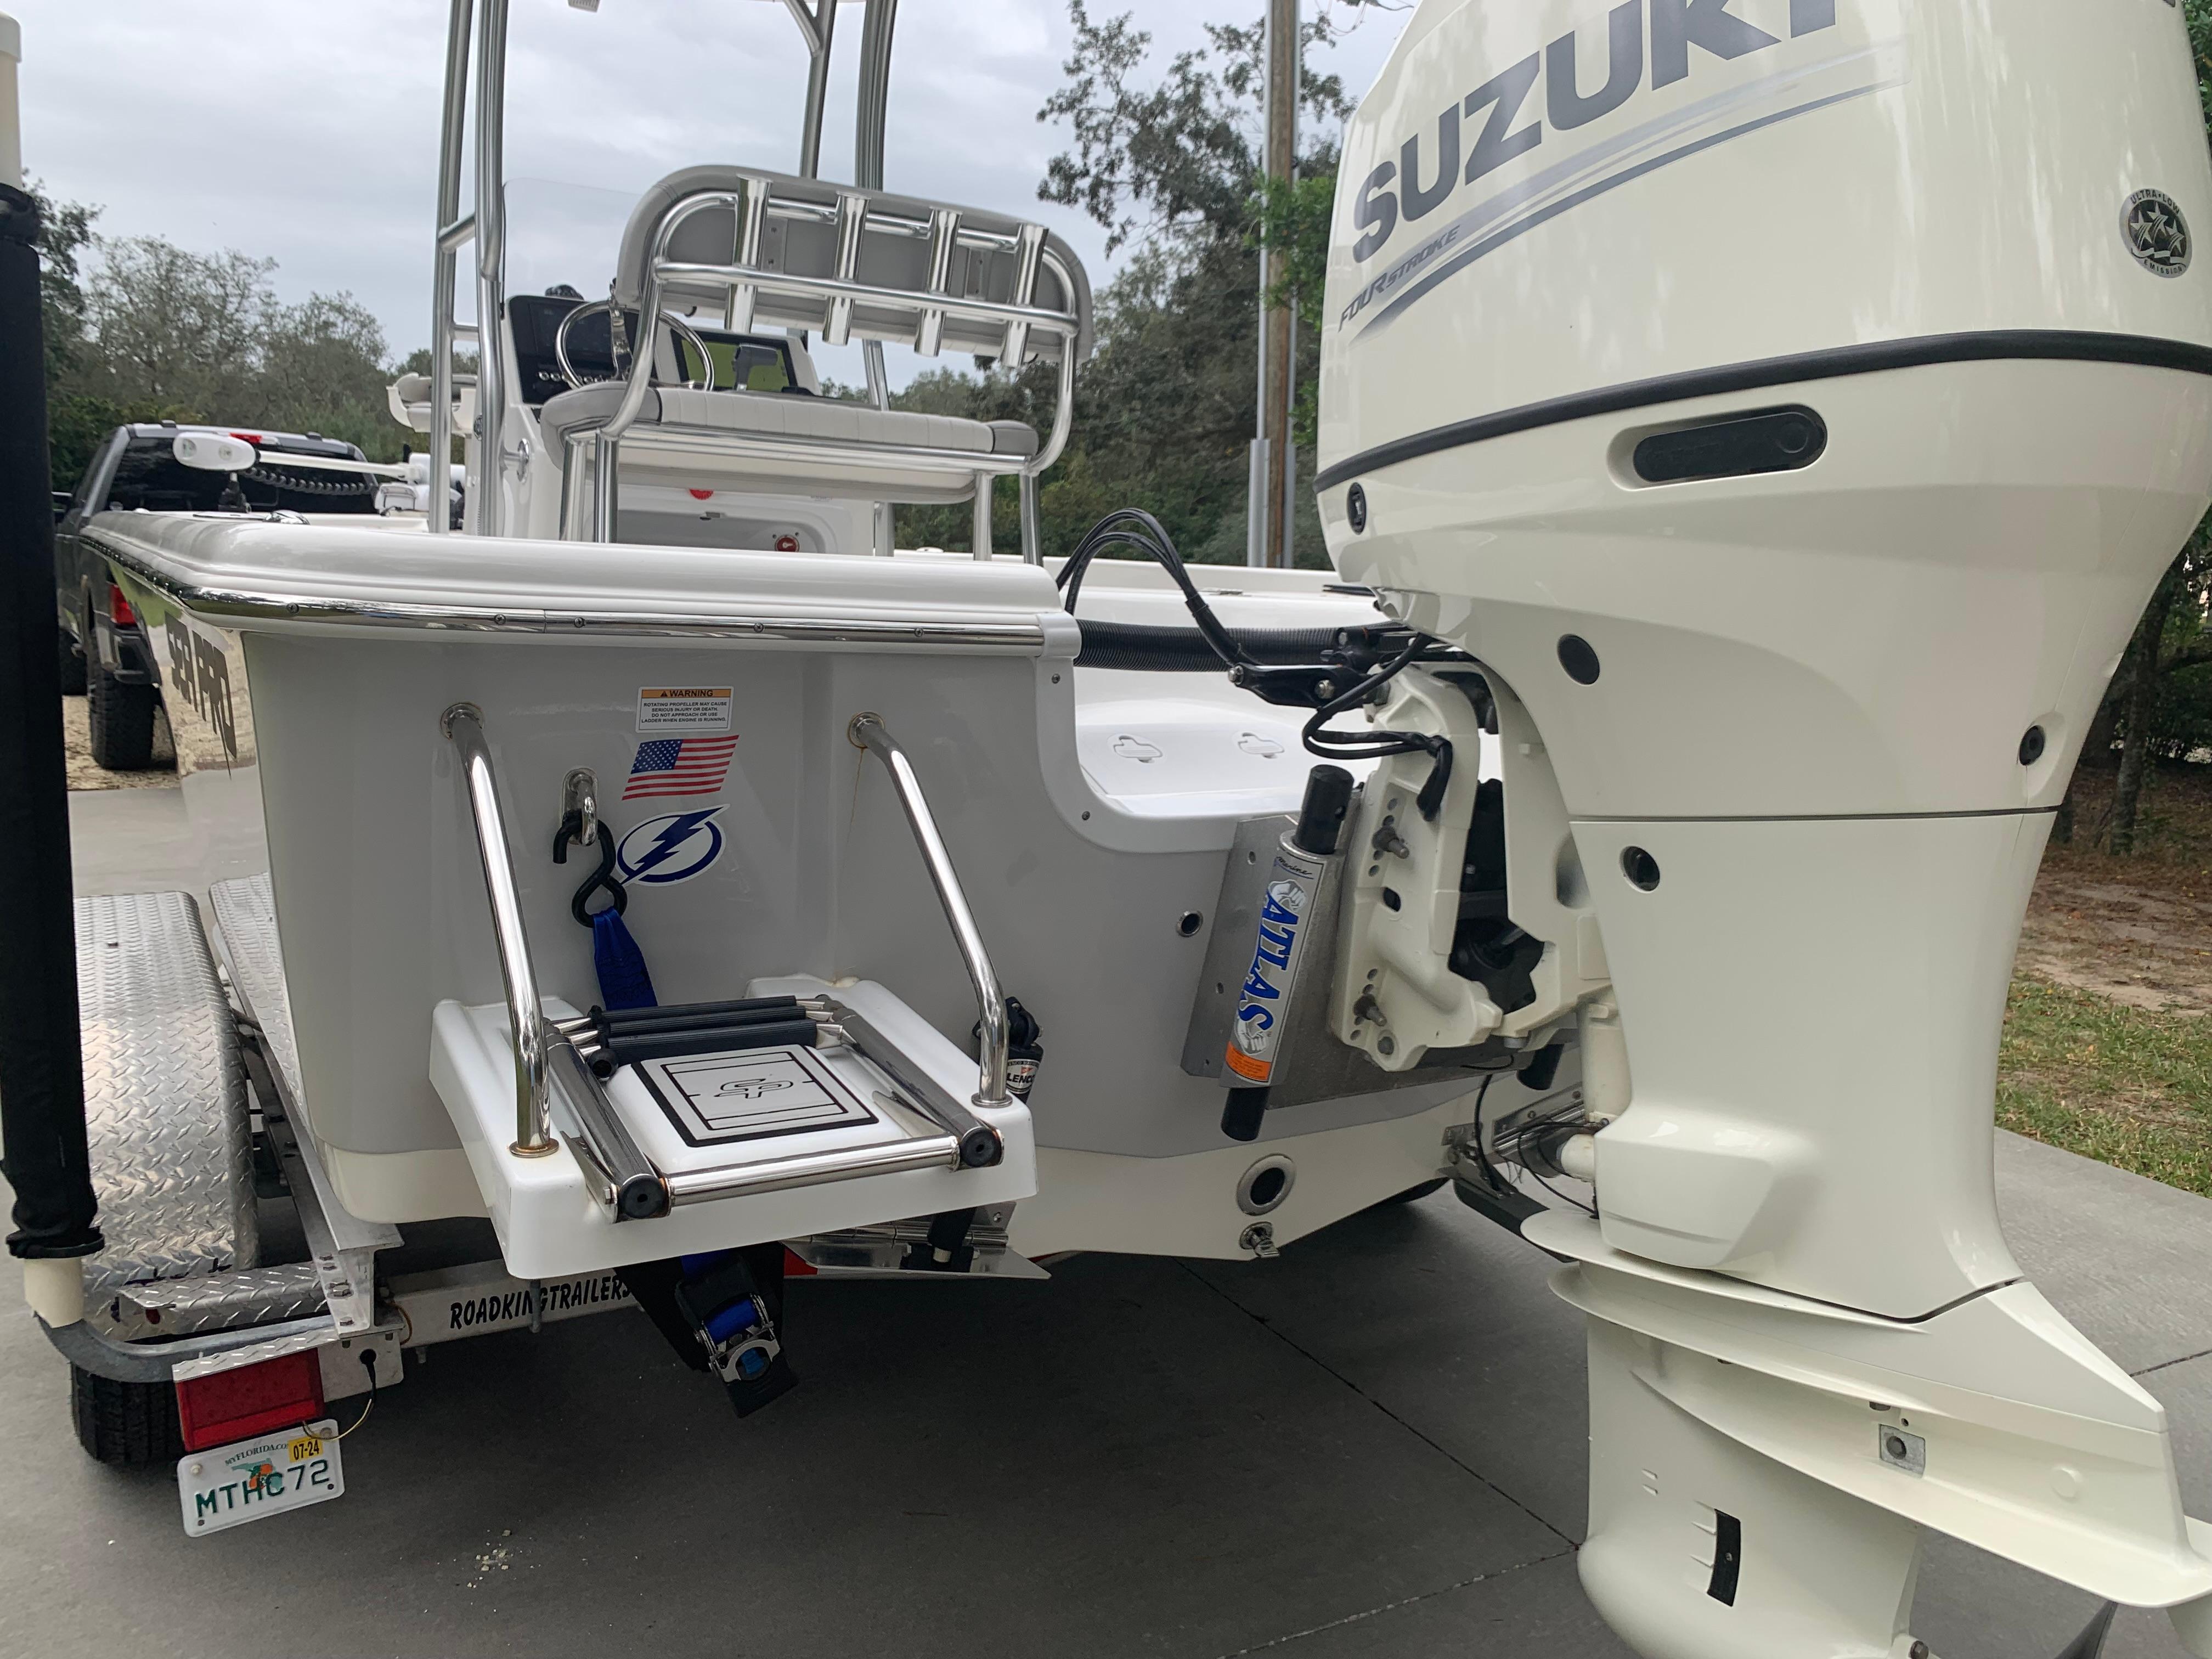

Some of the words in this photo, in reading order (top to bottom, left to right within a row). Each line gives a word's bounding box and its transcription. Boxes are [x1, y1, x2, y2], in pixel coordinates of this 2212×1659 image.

[1352, 0, 1836, 263] SUZUK
[2144, 259, 2182, 275] EMISSION
[165, 610, 199, 713] SEA
[192, 630, 237, 780] PRO
[1236, 887, 1301, 1032] ATLAS
[195, 1459, 330, 1518] MTHC72
[292, 1439, 320, 1461] 07-24
